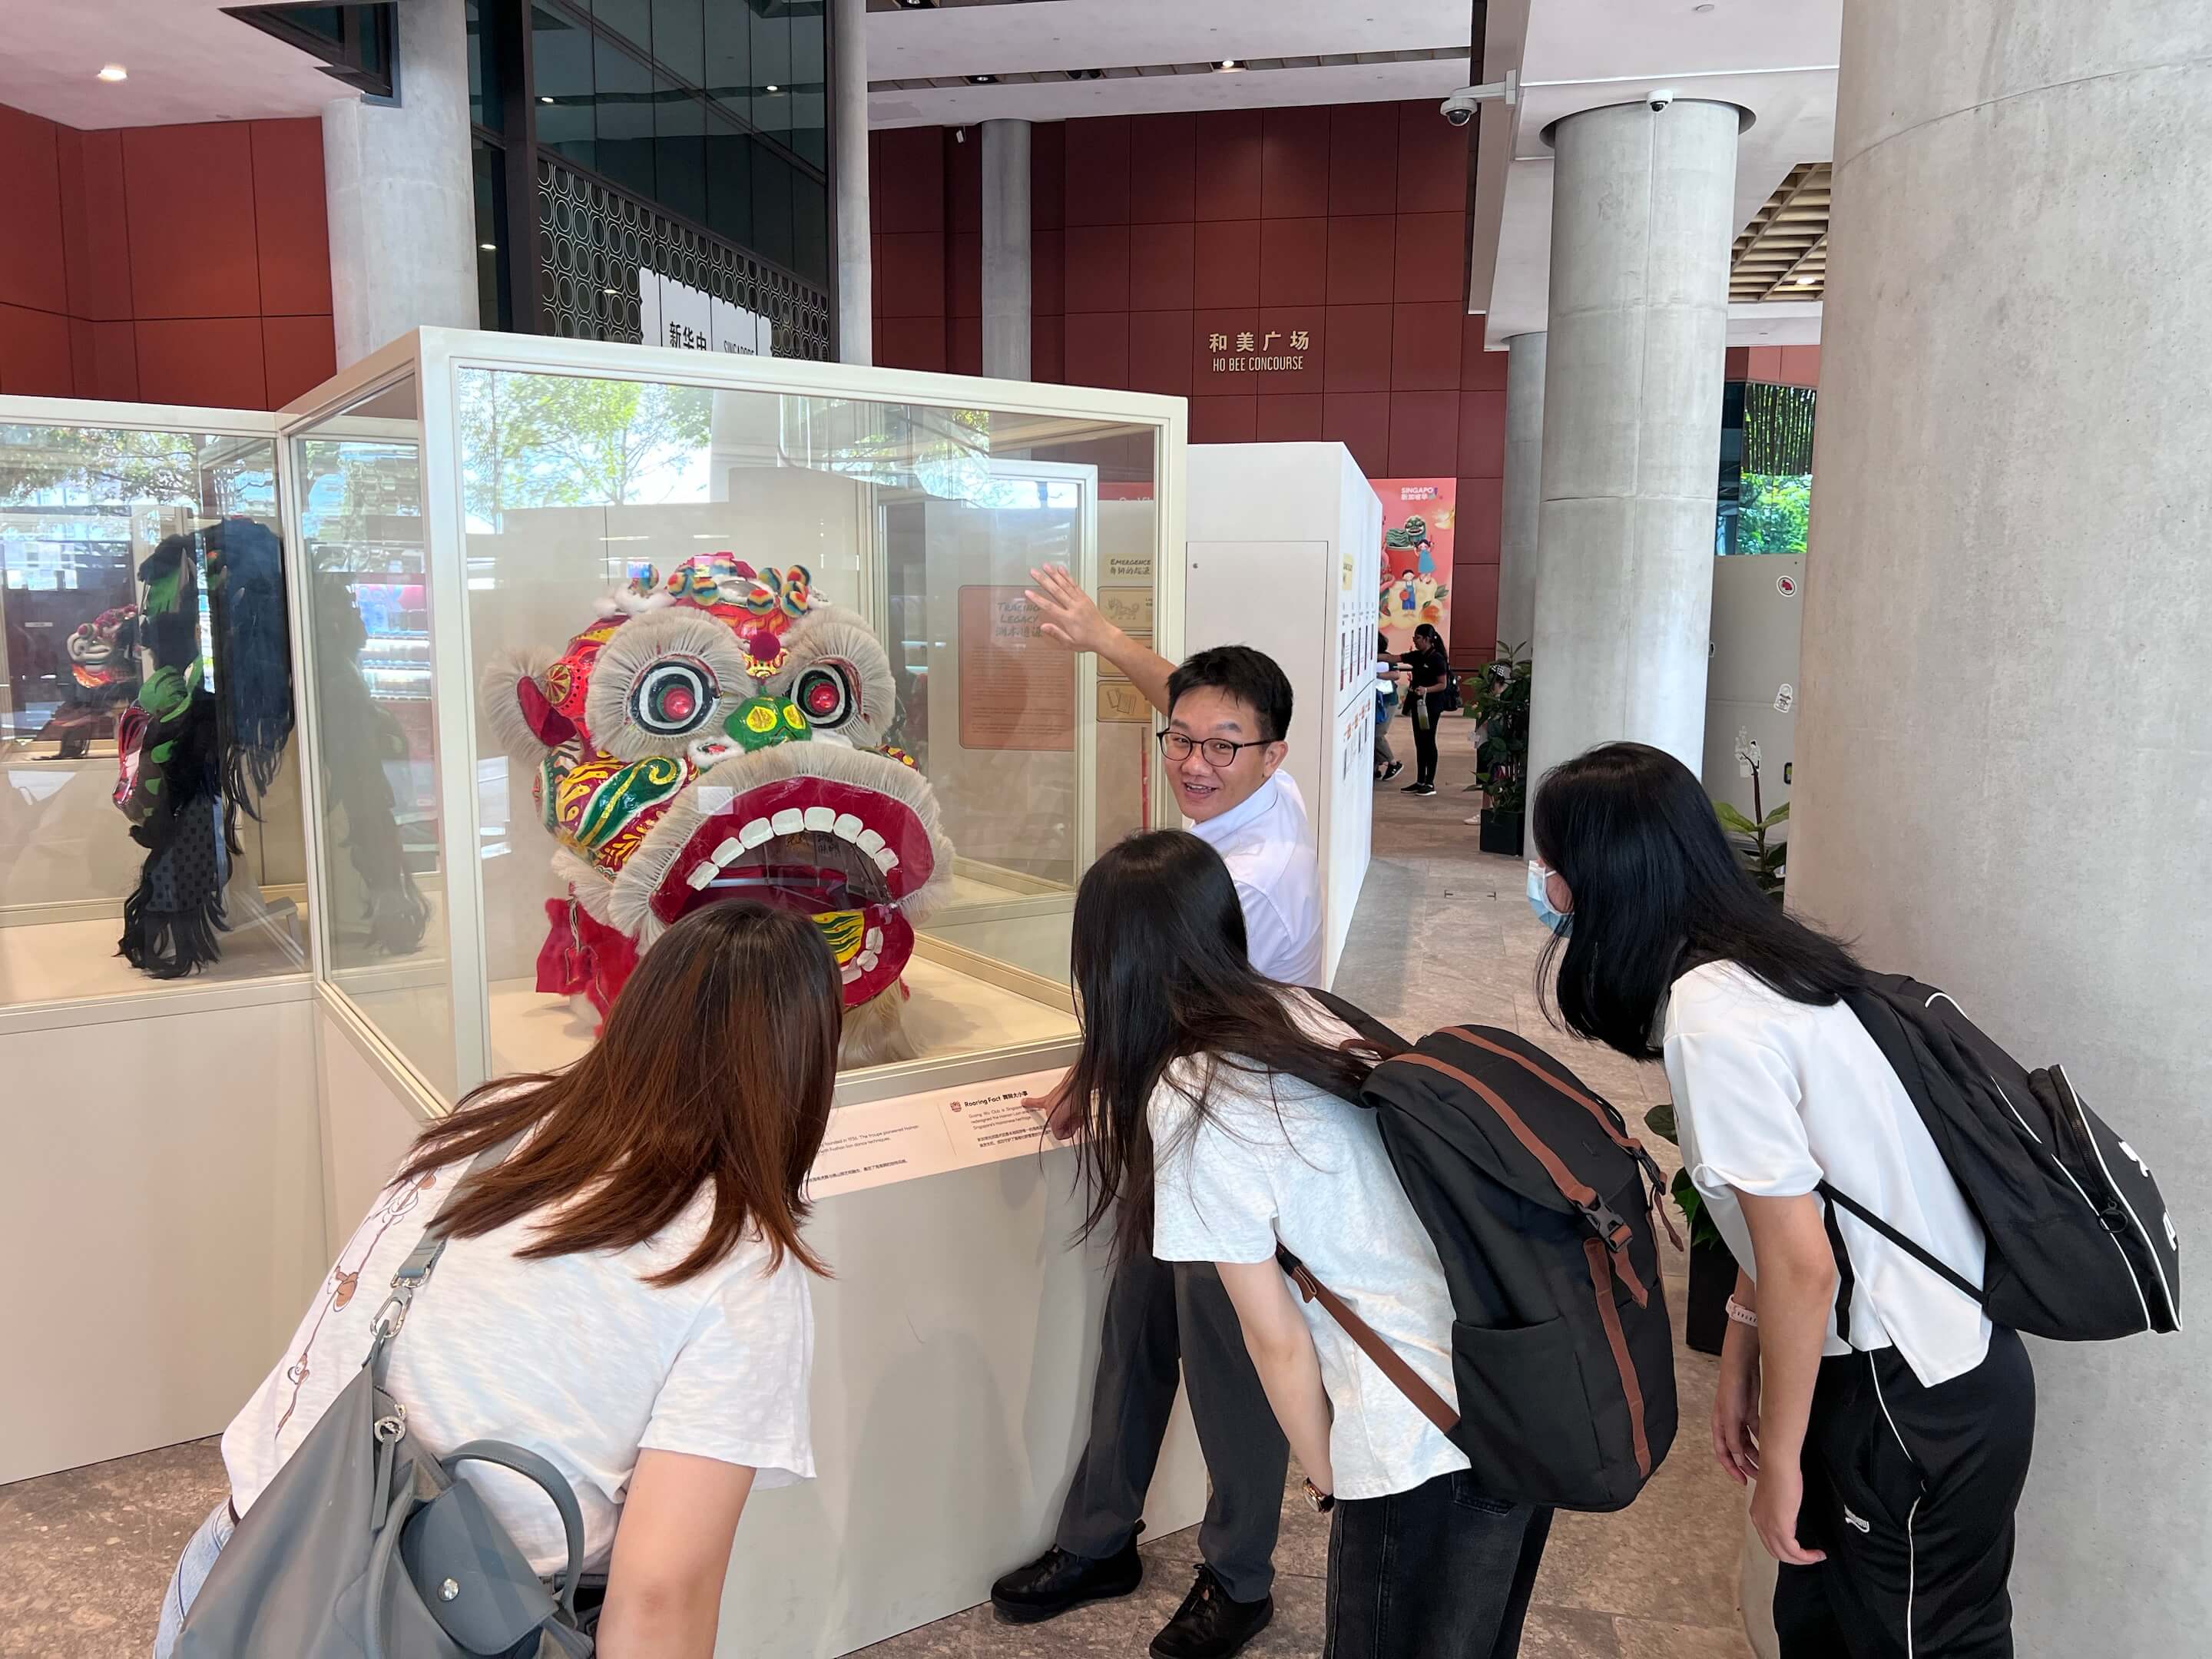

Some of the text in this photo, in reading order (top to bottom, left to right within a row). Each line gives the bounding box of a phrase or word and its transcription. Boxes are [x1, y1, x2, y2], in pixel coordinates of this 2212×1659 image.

[1209, 331, 1310, 353] 和美广场
[1213, 356, 1303, 372] HO BEE CONCOURSE
[1001, 614, 1039, 624] LEGACY
[964, 1098, 988, 1108] Roaring
